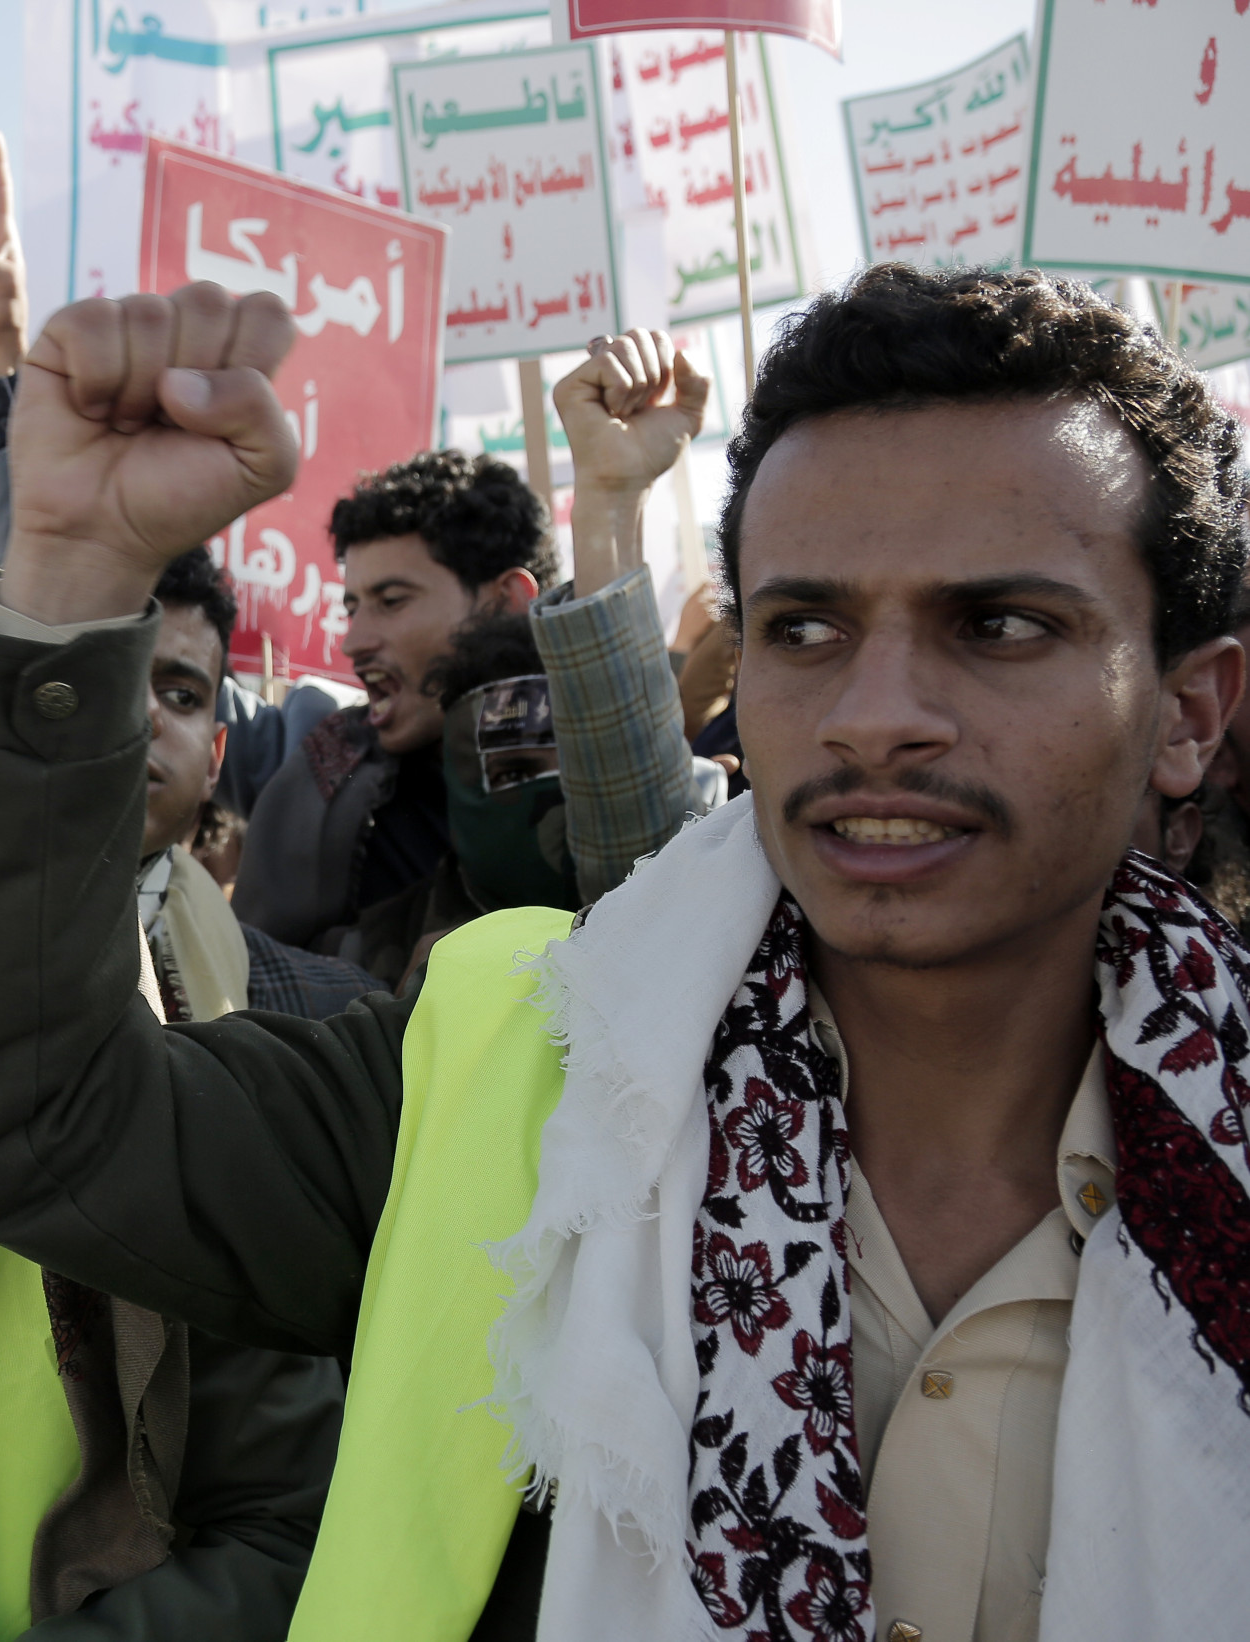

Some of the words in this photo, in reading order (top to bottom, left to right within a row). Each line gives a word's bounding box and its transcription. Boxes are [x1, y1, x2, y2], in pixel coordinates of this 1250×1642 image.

[407, 70, 587, 151] قاطعوا
[185, 199, 406, 346] أمريكا
[446, 271, 609, 338] الإسرائيلي
